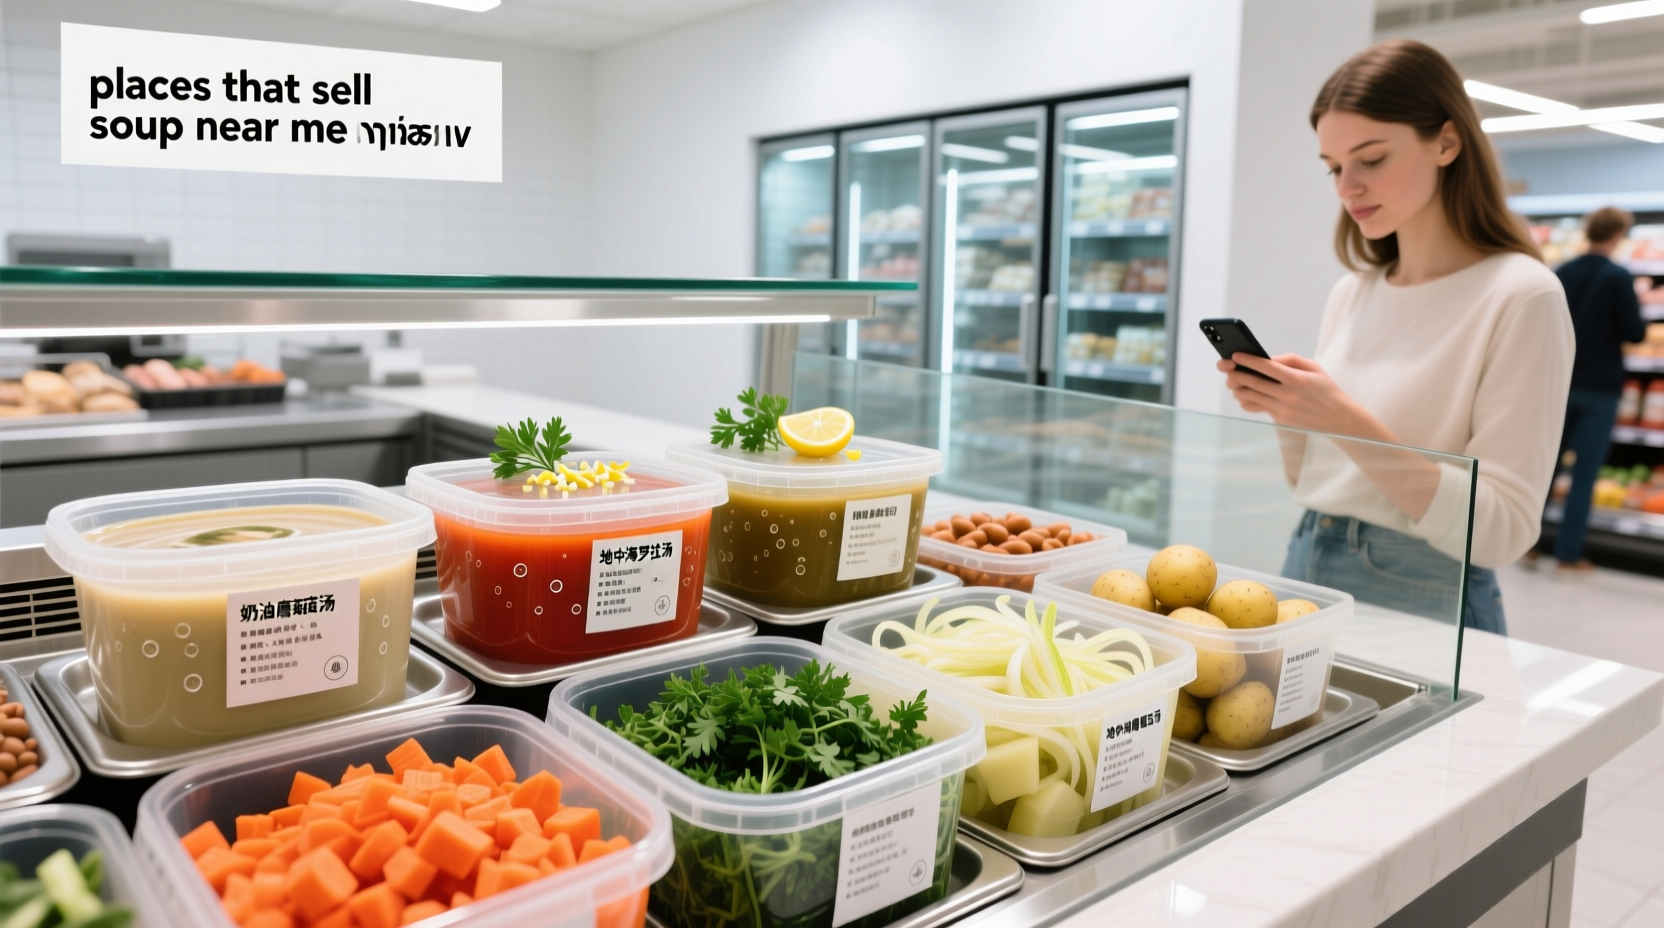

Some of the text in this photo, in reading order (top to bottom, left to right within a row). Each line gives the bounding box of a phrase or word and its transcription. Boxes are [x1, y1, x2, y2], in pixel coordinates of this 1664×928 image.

[90, 66, 372, 110] places that sell
[89, 115, 184, 150] soup
[196, 117, 280, 143] near
[291, 119, 348, 145] me
